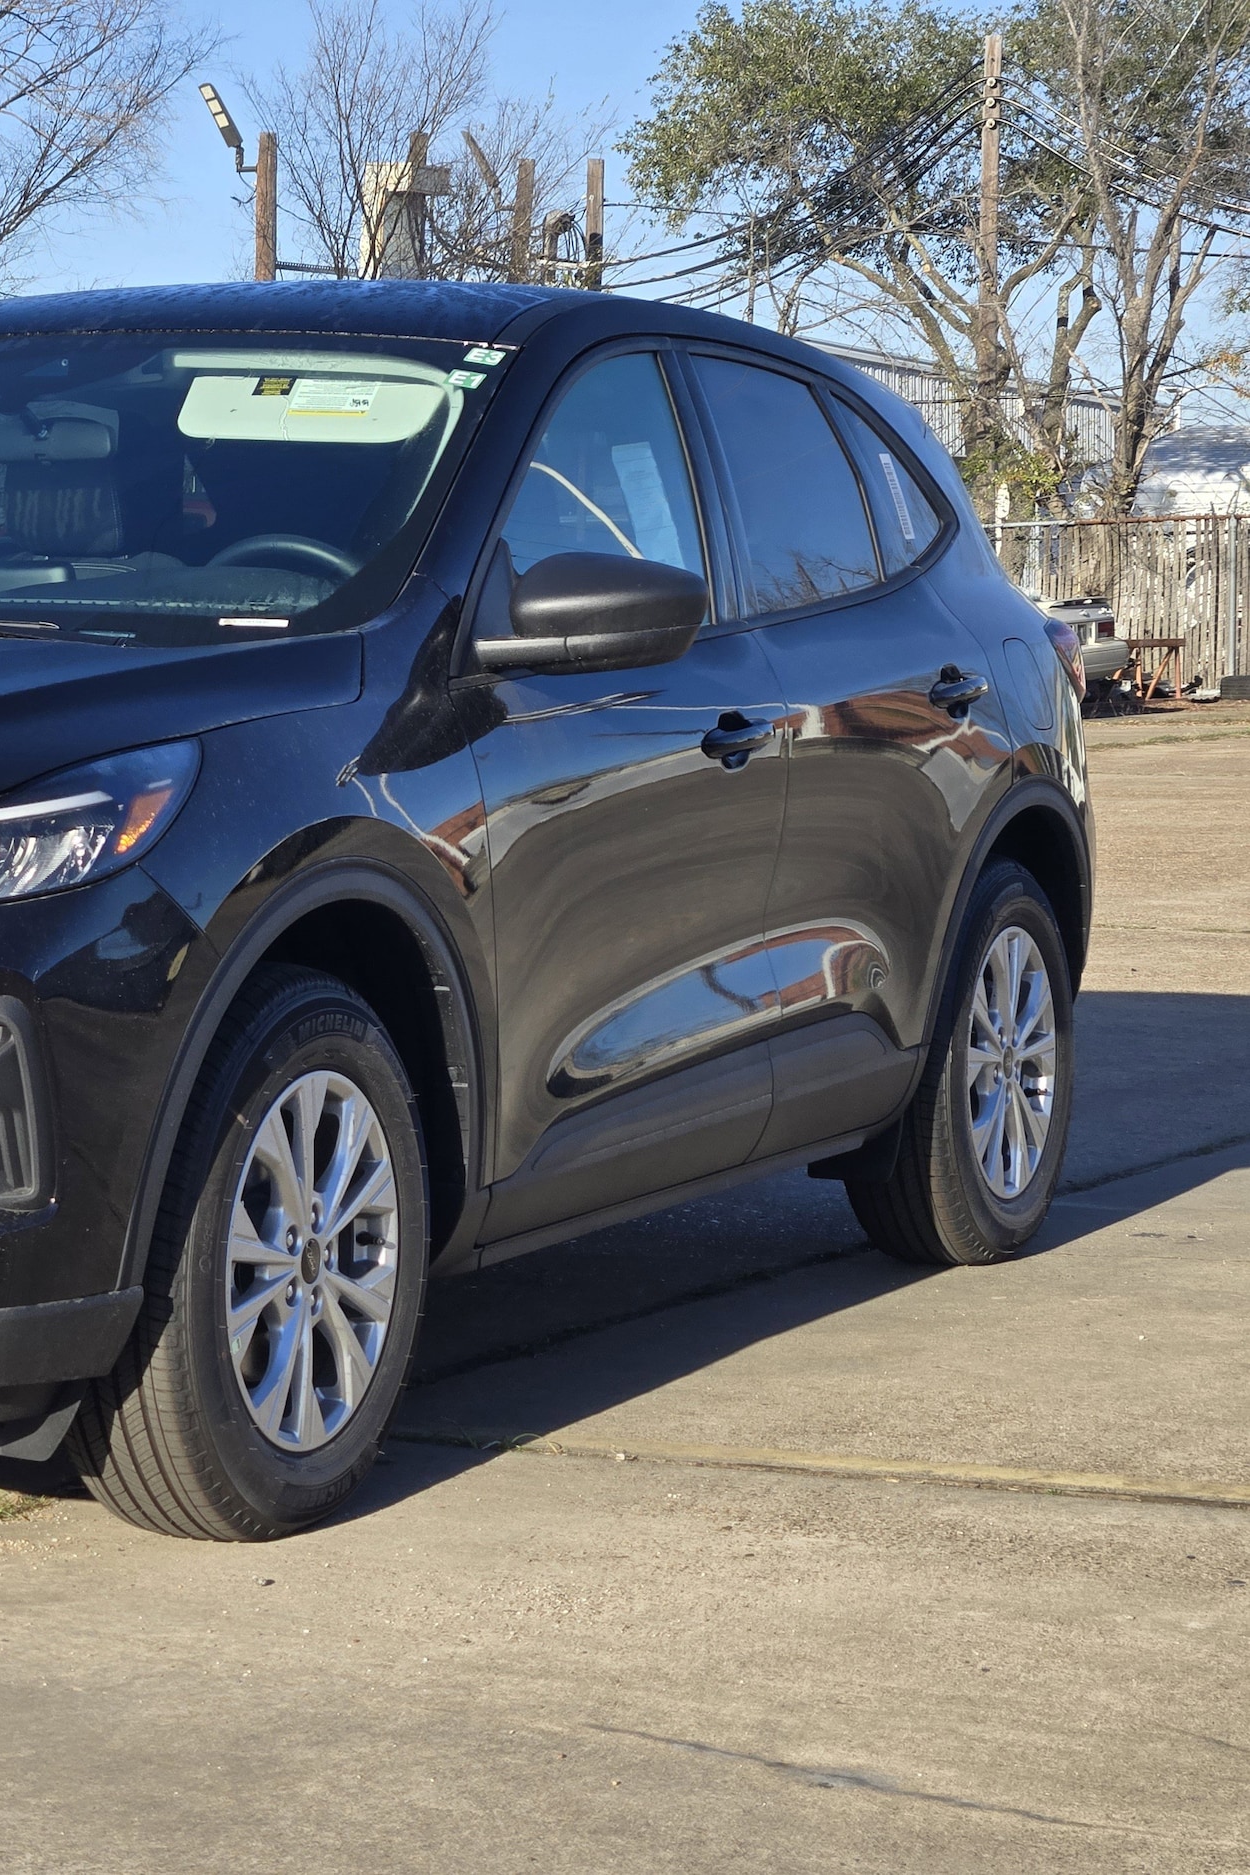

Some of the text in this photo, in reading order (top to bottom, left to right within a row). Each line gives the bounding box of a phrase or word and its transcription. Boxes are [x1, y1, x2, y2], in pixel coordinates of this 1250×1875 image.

[467, 349, 502, 363] E3
[448, 370, 484, 387] E1
[298, 1013, 366, 1042] MICHELIN
